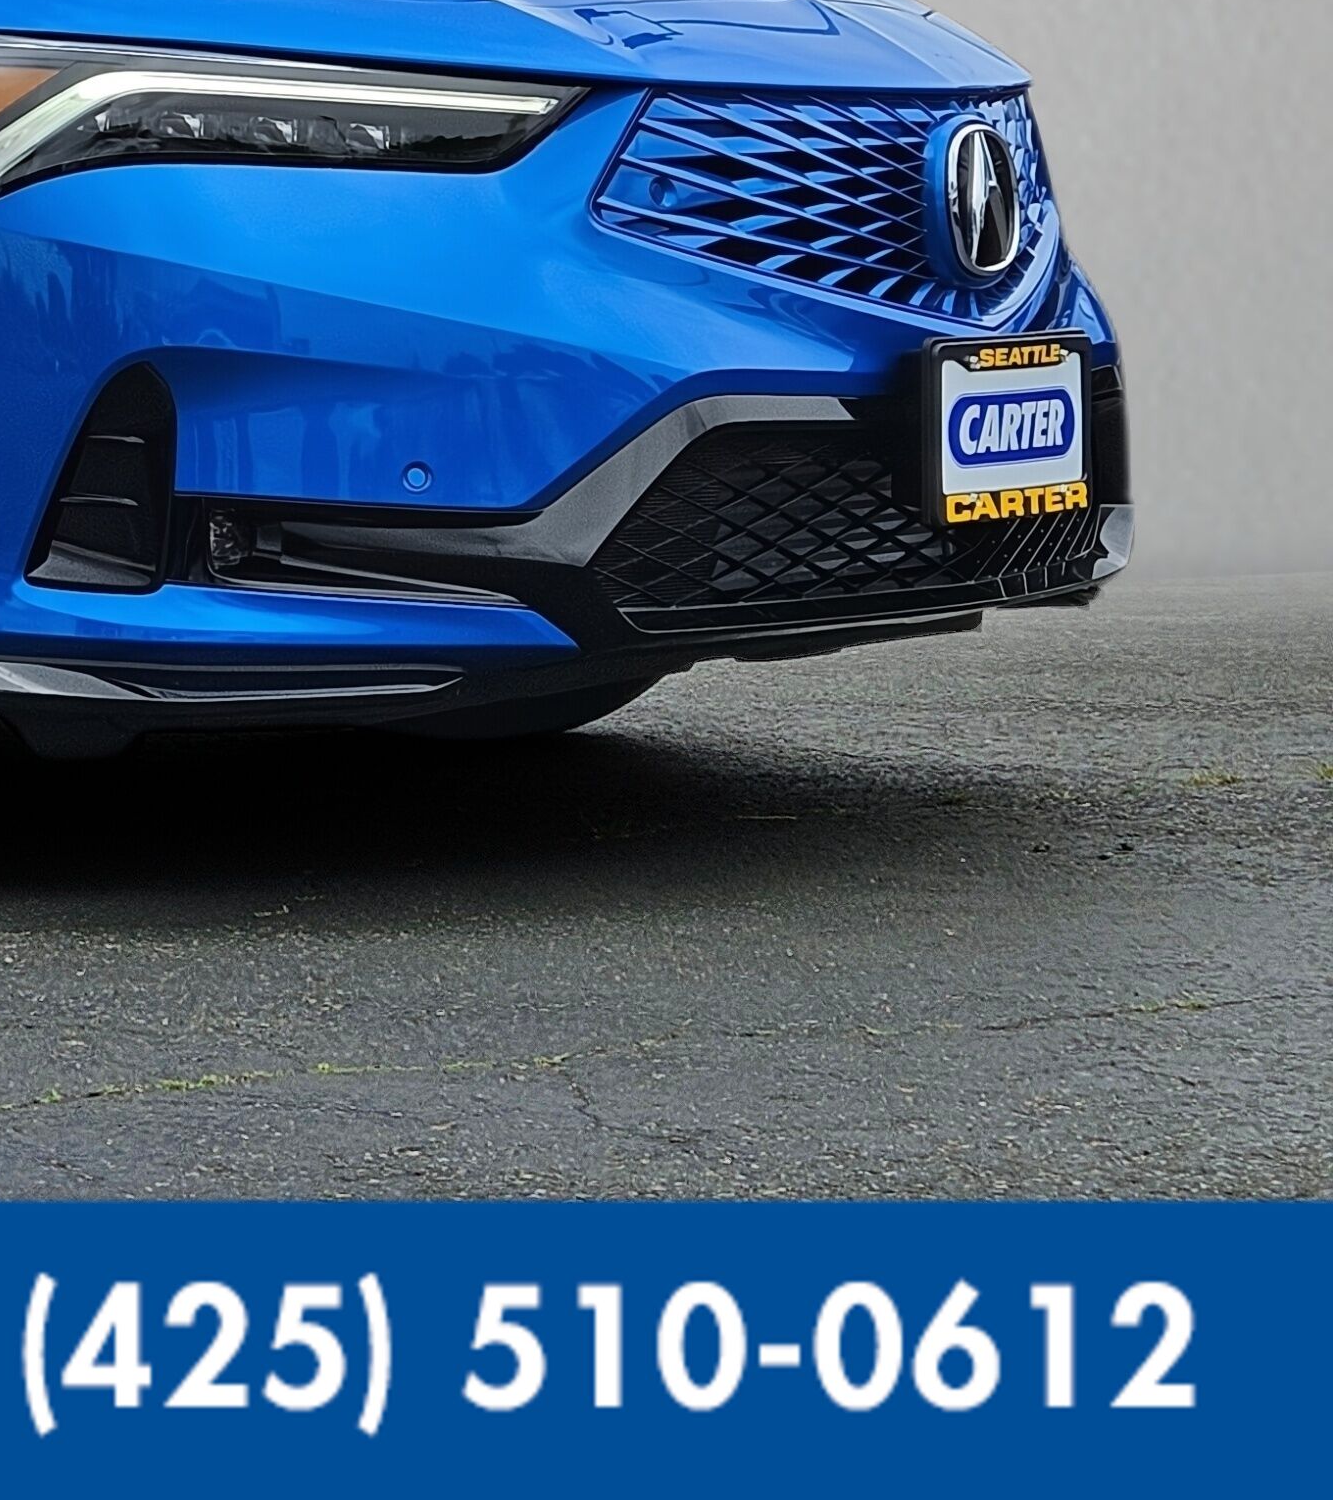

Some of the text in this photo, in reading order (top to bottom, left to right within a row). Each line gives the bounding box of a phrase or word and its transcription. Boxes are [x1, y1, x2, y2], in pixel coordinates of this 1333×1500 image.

[979, 344, 1061, 367] SEATTLE
[959, 399, 1066, 455] CARTER
[945, 481, 1088, 523] CARTER
